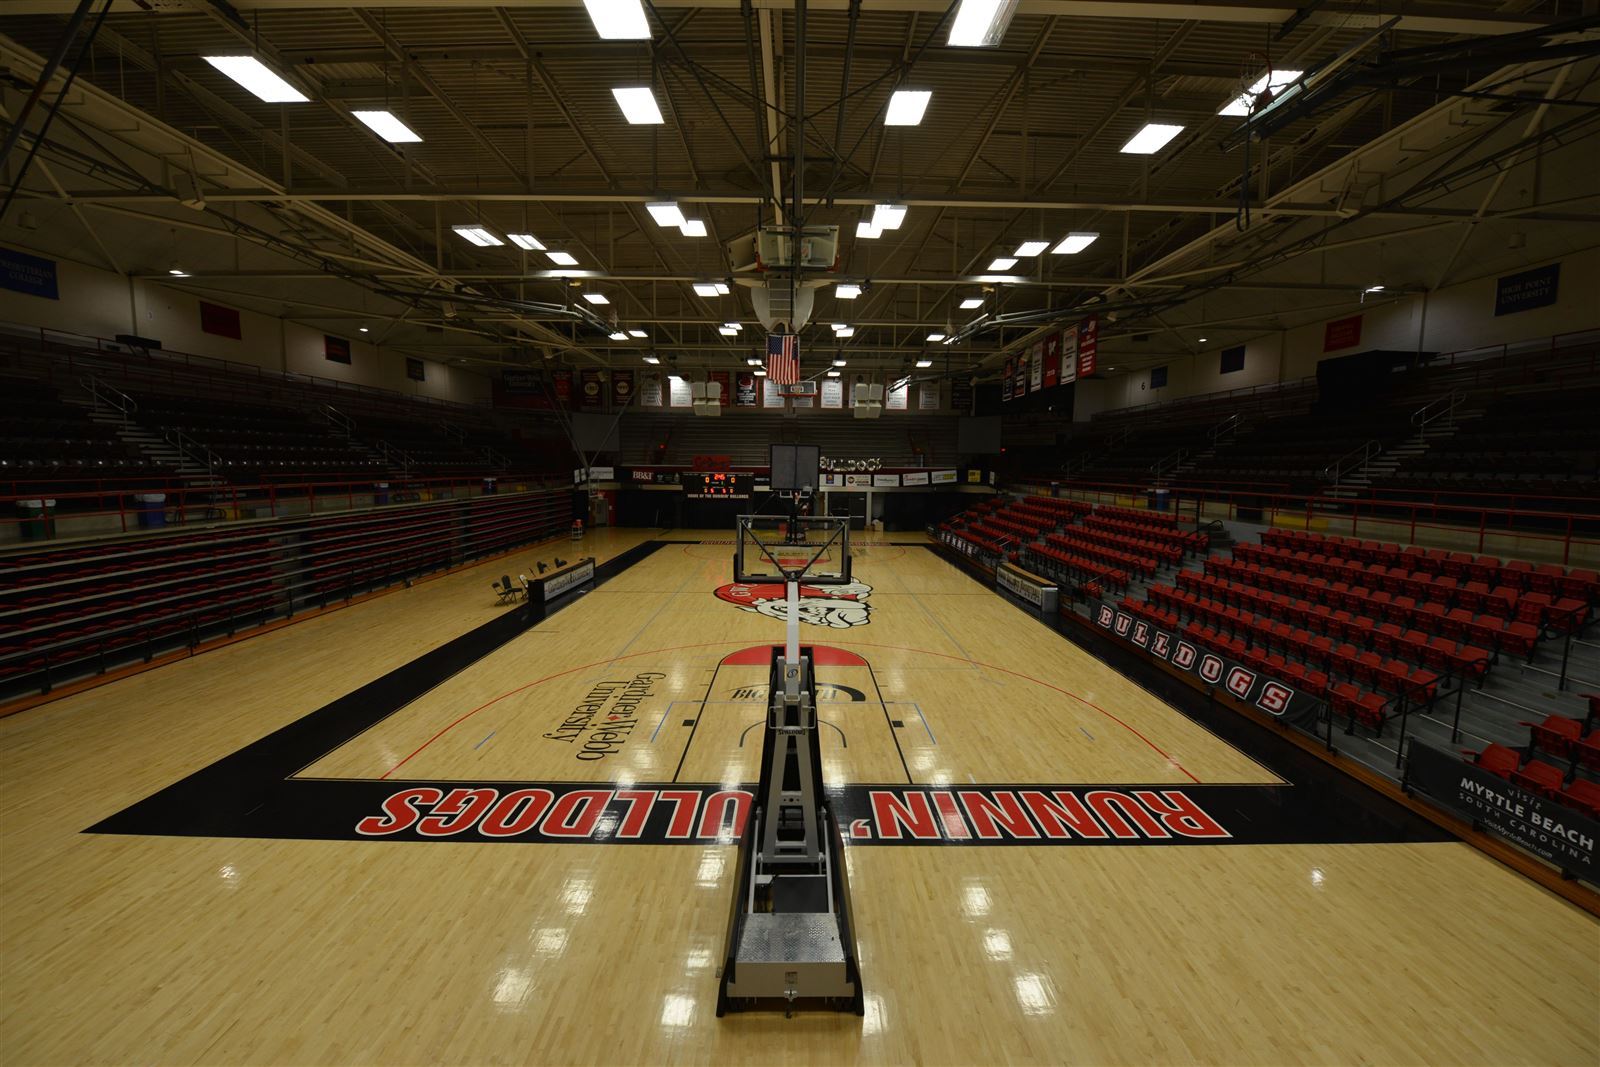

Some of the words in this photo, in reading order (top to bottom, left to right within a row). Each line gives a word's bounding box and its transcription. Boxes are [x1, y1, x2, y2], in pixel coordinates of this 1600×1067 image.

[632, 471, 653, 480] BB&T
[1097, 604, 1294, 715] BULLDOGS
[542, 680, 631, 744] University
[354, 787, 756, 839] ULLDOGS
[850, 790, 1234, 839] RUNNIN'
[1459, 792, 1501, 819] SOUTH
[1509, 819, 1591, 865] CAROLINA
[1460, 777, 1525, 818] MYRTLE
[1531, 811, 1594, 851] BEACH
[1507, 788, 1542, 811] visit
